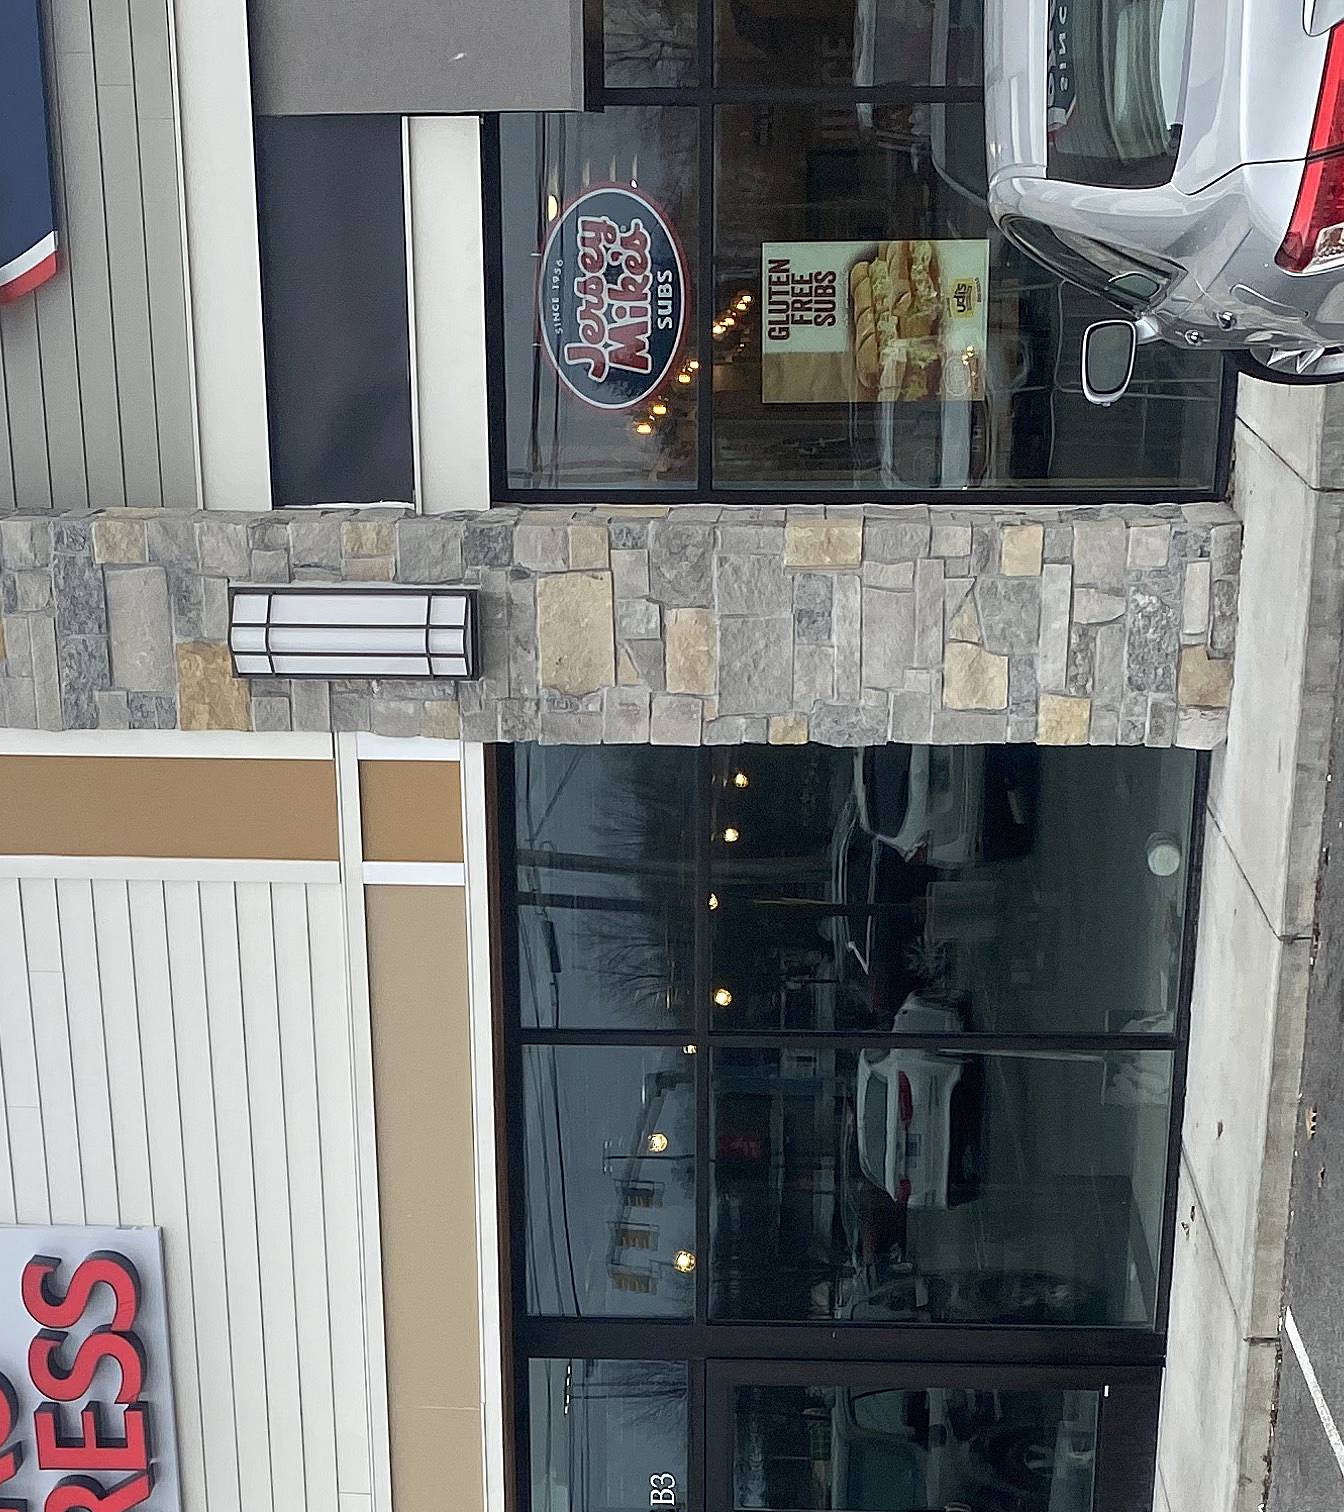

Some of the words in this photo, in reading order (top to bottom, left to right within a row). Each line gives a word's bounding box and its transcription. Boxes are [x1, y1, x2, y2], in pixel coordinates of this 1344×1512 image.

[551, 297, 564, 335] SINCE
[564, 215, 617, 383] Jersey
[606, 218, 653, 374] Mike's
[656, 269, 673, 330] SUBS
[767, 259, 790, 341] GLUTEN
[790, 272, 813, 325] FREE
[813, 270, 837, 327] SUBS
[649, 1473, 676, 1506] B3
